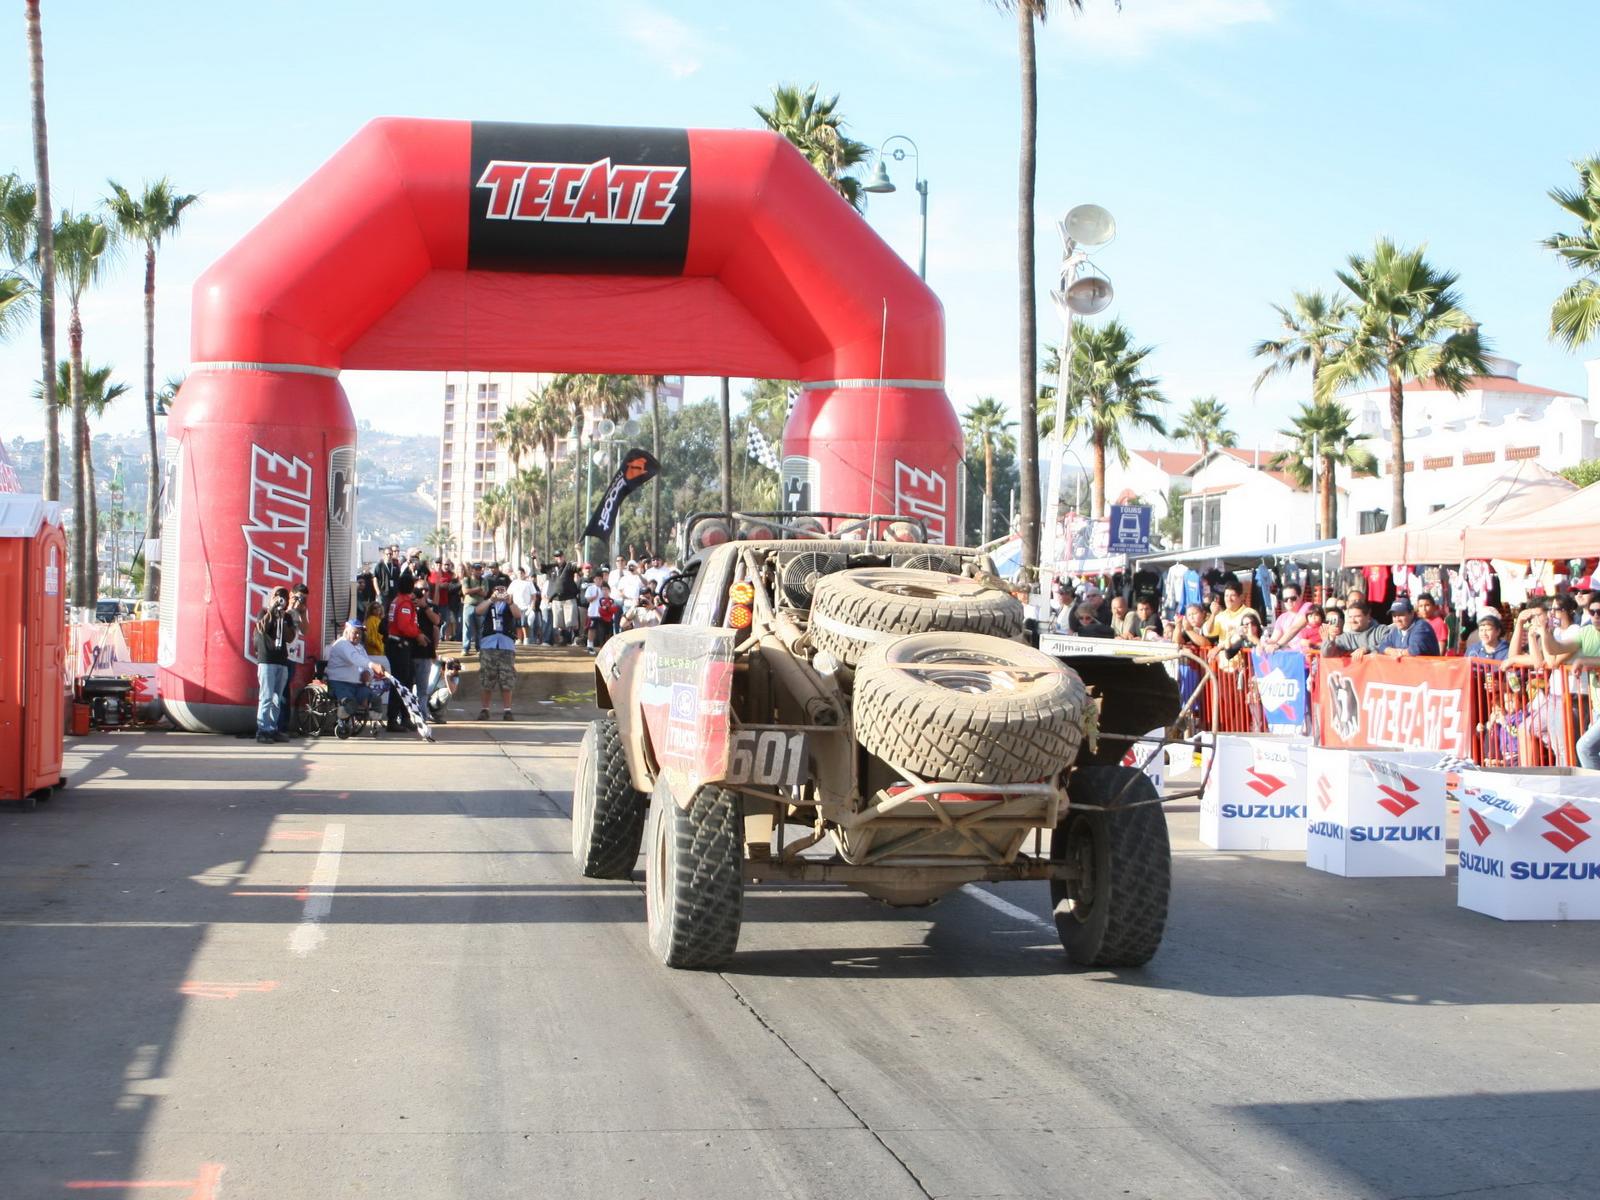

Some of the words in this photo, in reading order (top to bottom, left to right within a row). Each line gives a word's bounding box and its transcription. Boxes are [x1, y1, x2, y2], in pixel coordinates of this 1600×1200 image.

[476, 157, 687, 225] TECATE
[1119, 506, 1142, 514] TOURS
[1052, 642, 1094, 653] Allmand
[1362, 681, 1463, 755] TECATE
[724, 730, 805, 786] 601
[1221, 803, 1307, 818] SUZUKI
[1308, 820, 1344, 840] SUZUKI
[1349, 825, 1441, 841] SUZUKI
[1459, 850, 1504, 878] SUZUKI
